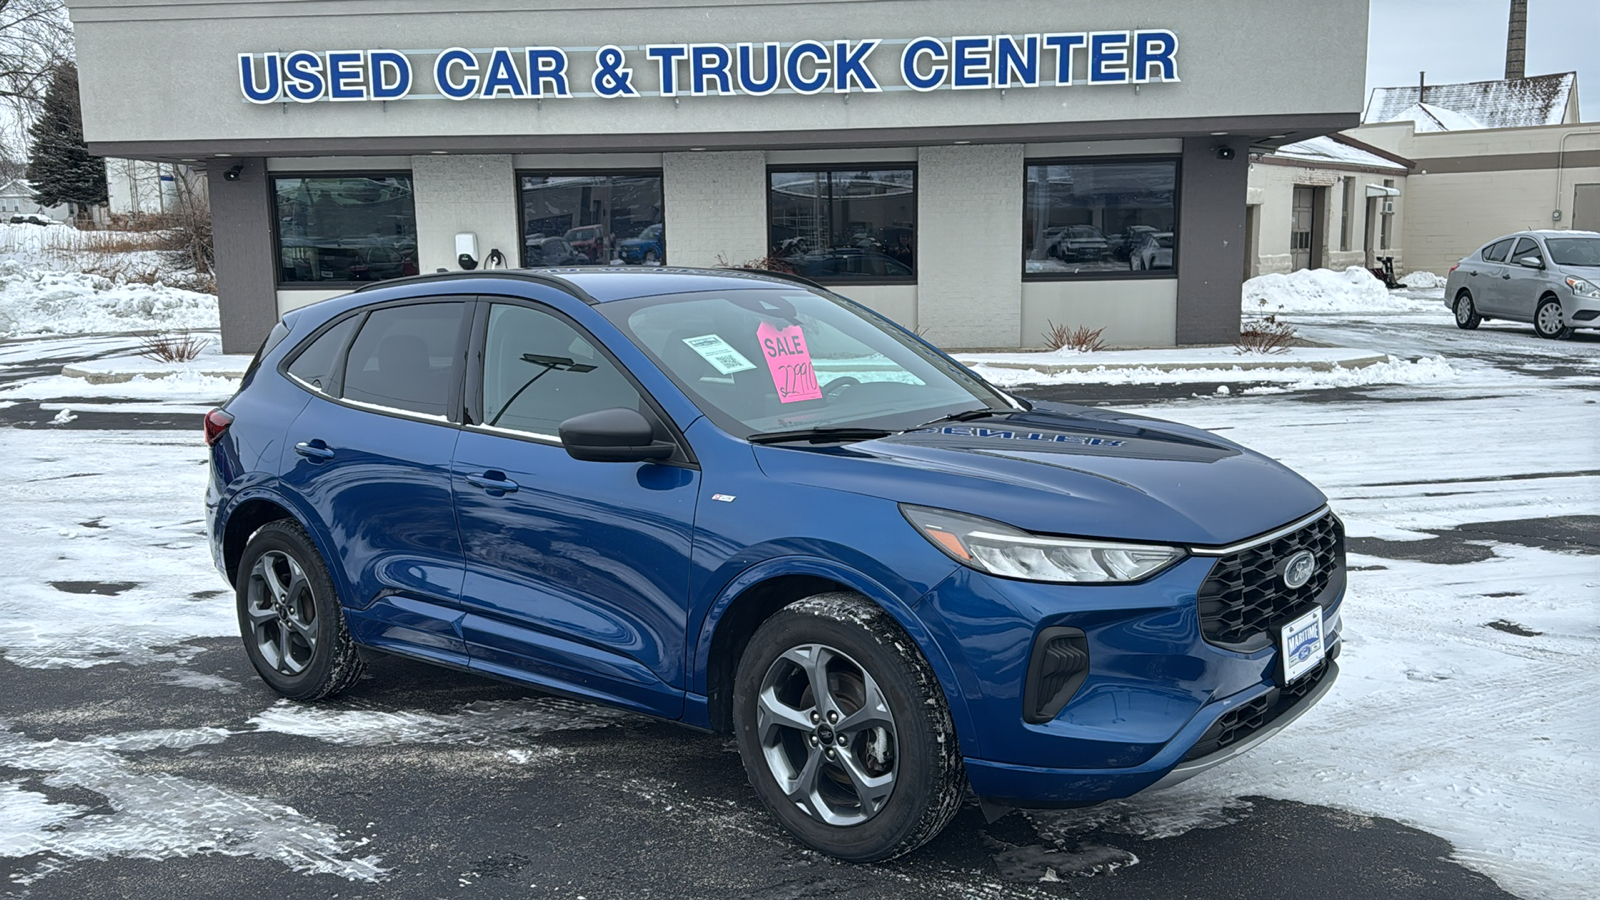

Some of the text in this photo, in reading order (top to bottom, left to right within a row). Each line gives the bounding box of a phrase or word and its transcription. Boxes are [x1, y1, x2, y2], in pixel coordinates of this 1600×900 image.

[238, 28, 1181, 104] USED CAR & TRUCK CENTER
[764, 336, 804, 358] SALE
[1288, 624, 1319, 655] MARITIME
